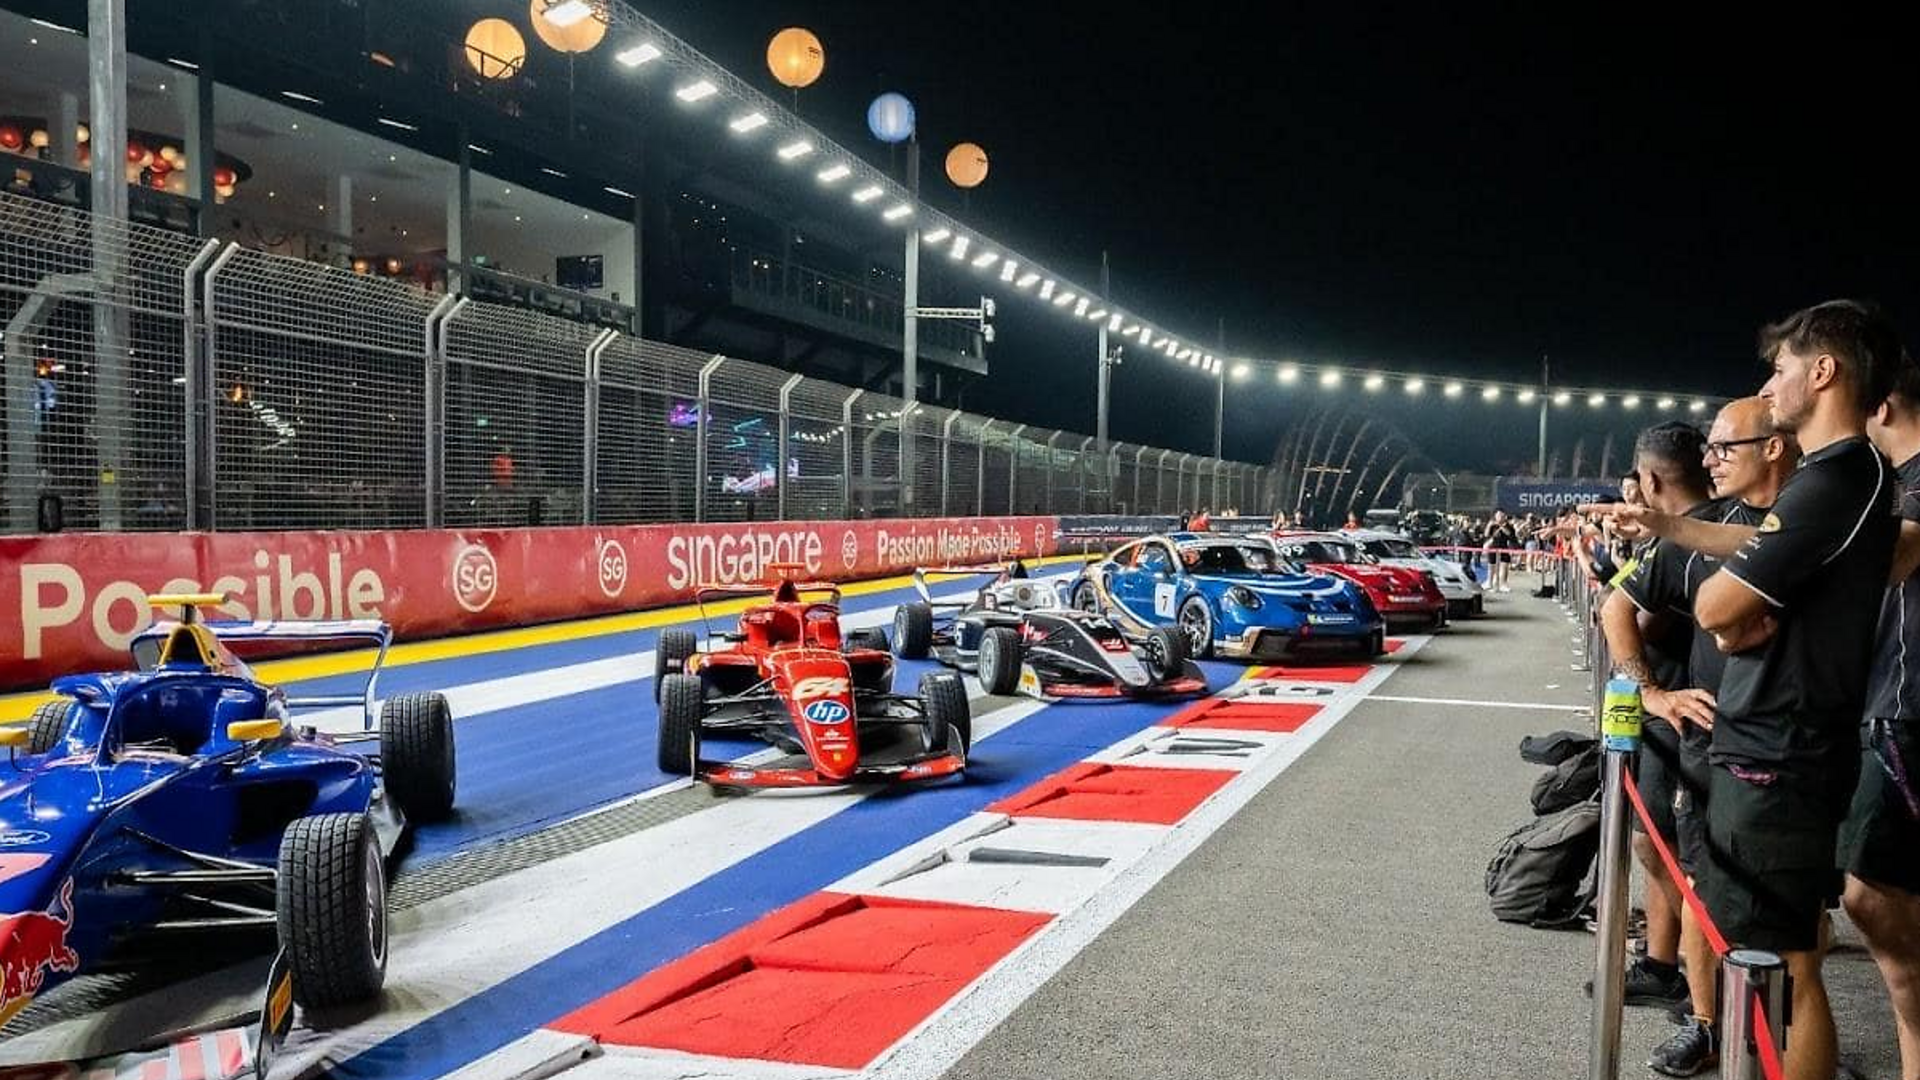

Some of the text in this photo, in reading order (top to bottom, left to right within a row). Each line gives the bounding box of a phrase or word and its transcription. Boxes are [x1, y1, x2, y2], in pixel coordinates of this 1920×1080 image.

[1518, 492, 1600, 508] SINGAPORE
[877, 525, 934, 566] Passion
[937, 527, 971, 560] Made
[971, 524, 1022, 556] Possible
[457, 562, 493, 592] SG
[601, 559, 625, 580] SG
[1160, 593, 1170, 613] 7
[1080, 618, 1113, 629] 14
[792, 676, 850, 701] 64
[811, 701, 844, 723] hp
